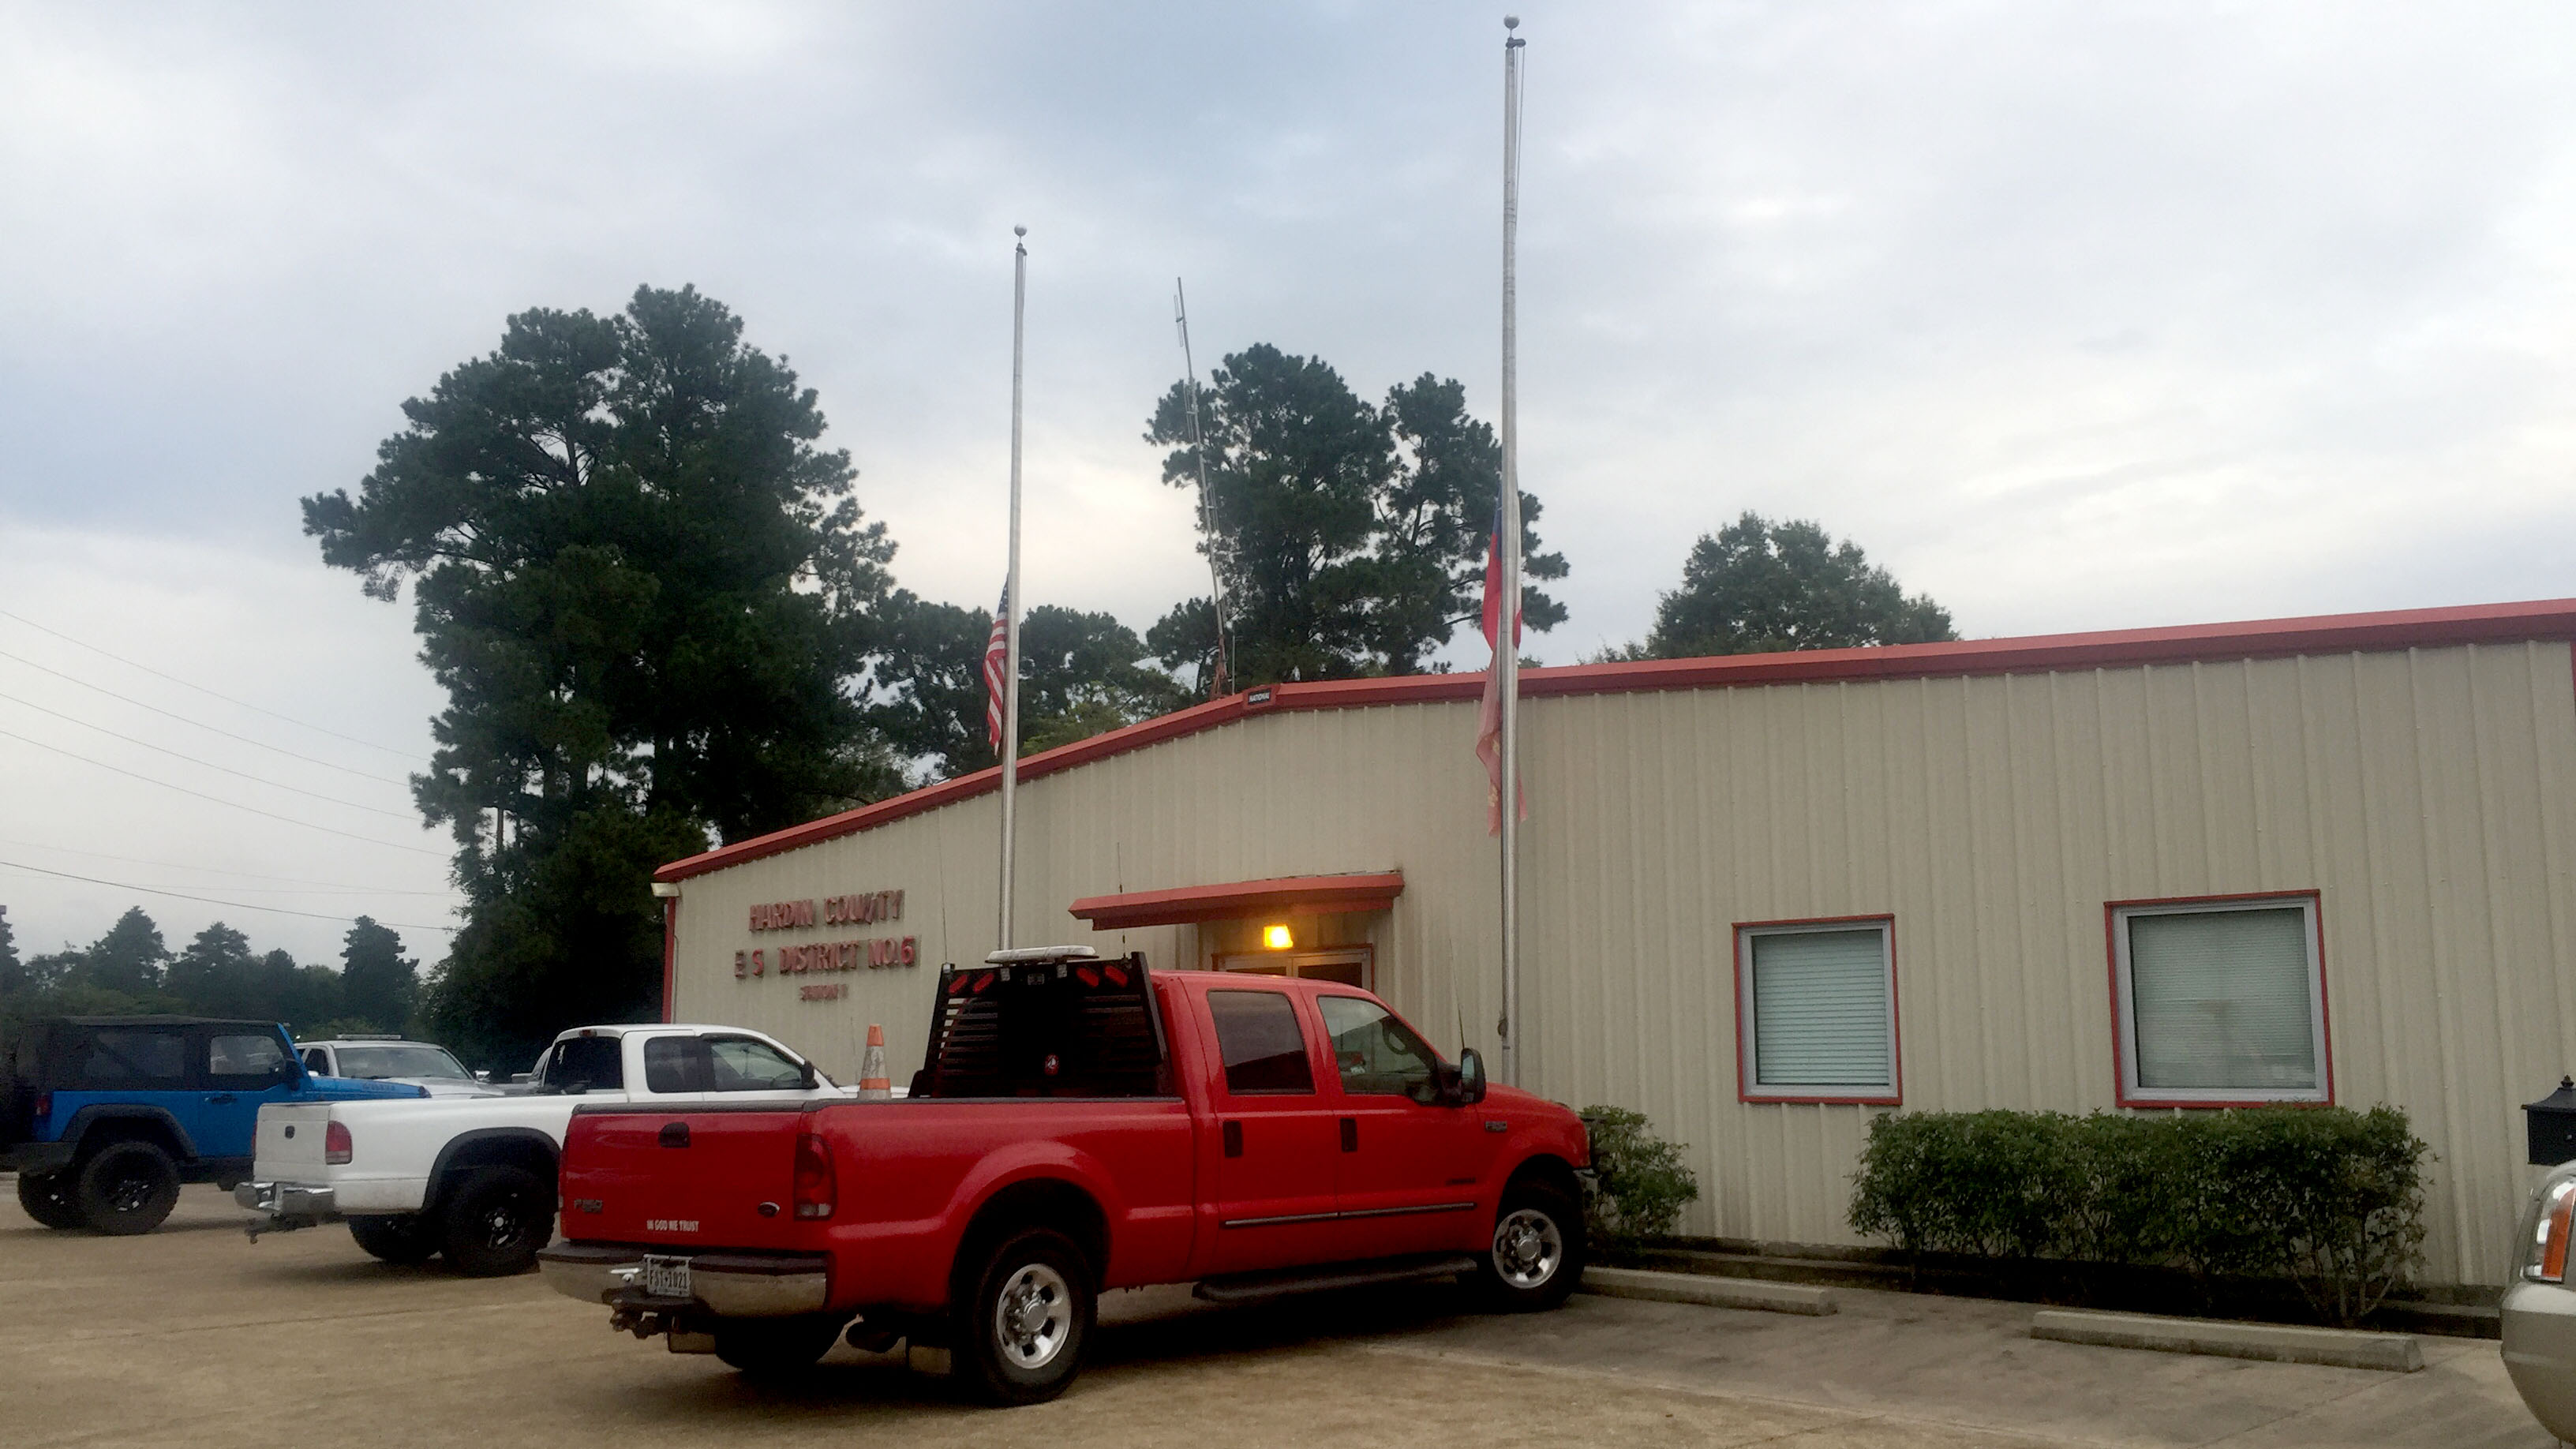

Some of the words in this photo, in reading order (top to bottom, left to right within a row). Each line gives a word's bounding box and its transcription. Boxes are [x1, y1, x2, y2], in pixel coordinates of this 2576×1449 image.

[824, 890, 905, 924] COUNTY
[777, 941, 859, 975] DISTRICT
[680, 1220, 699, 1232] TRUST
